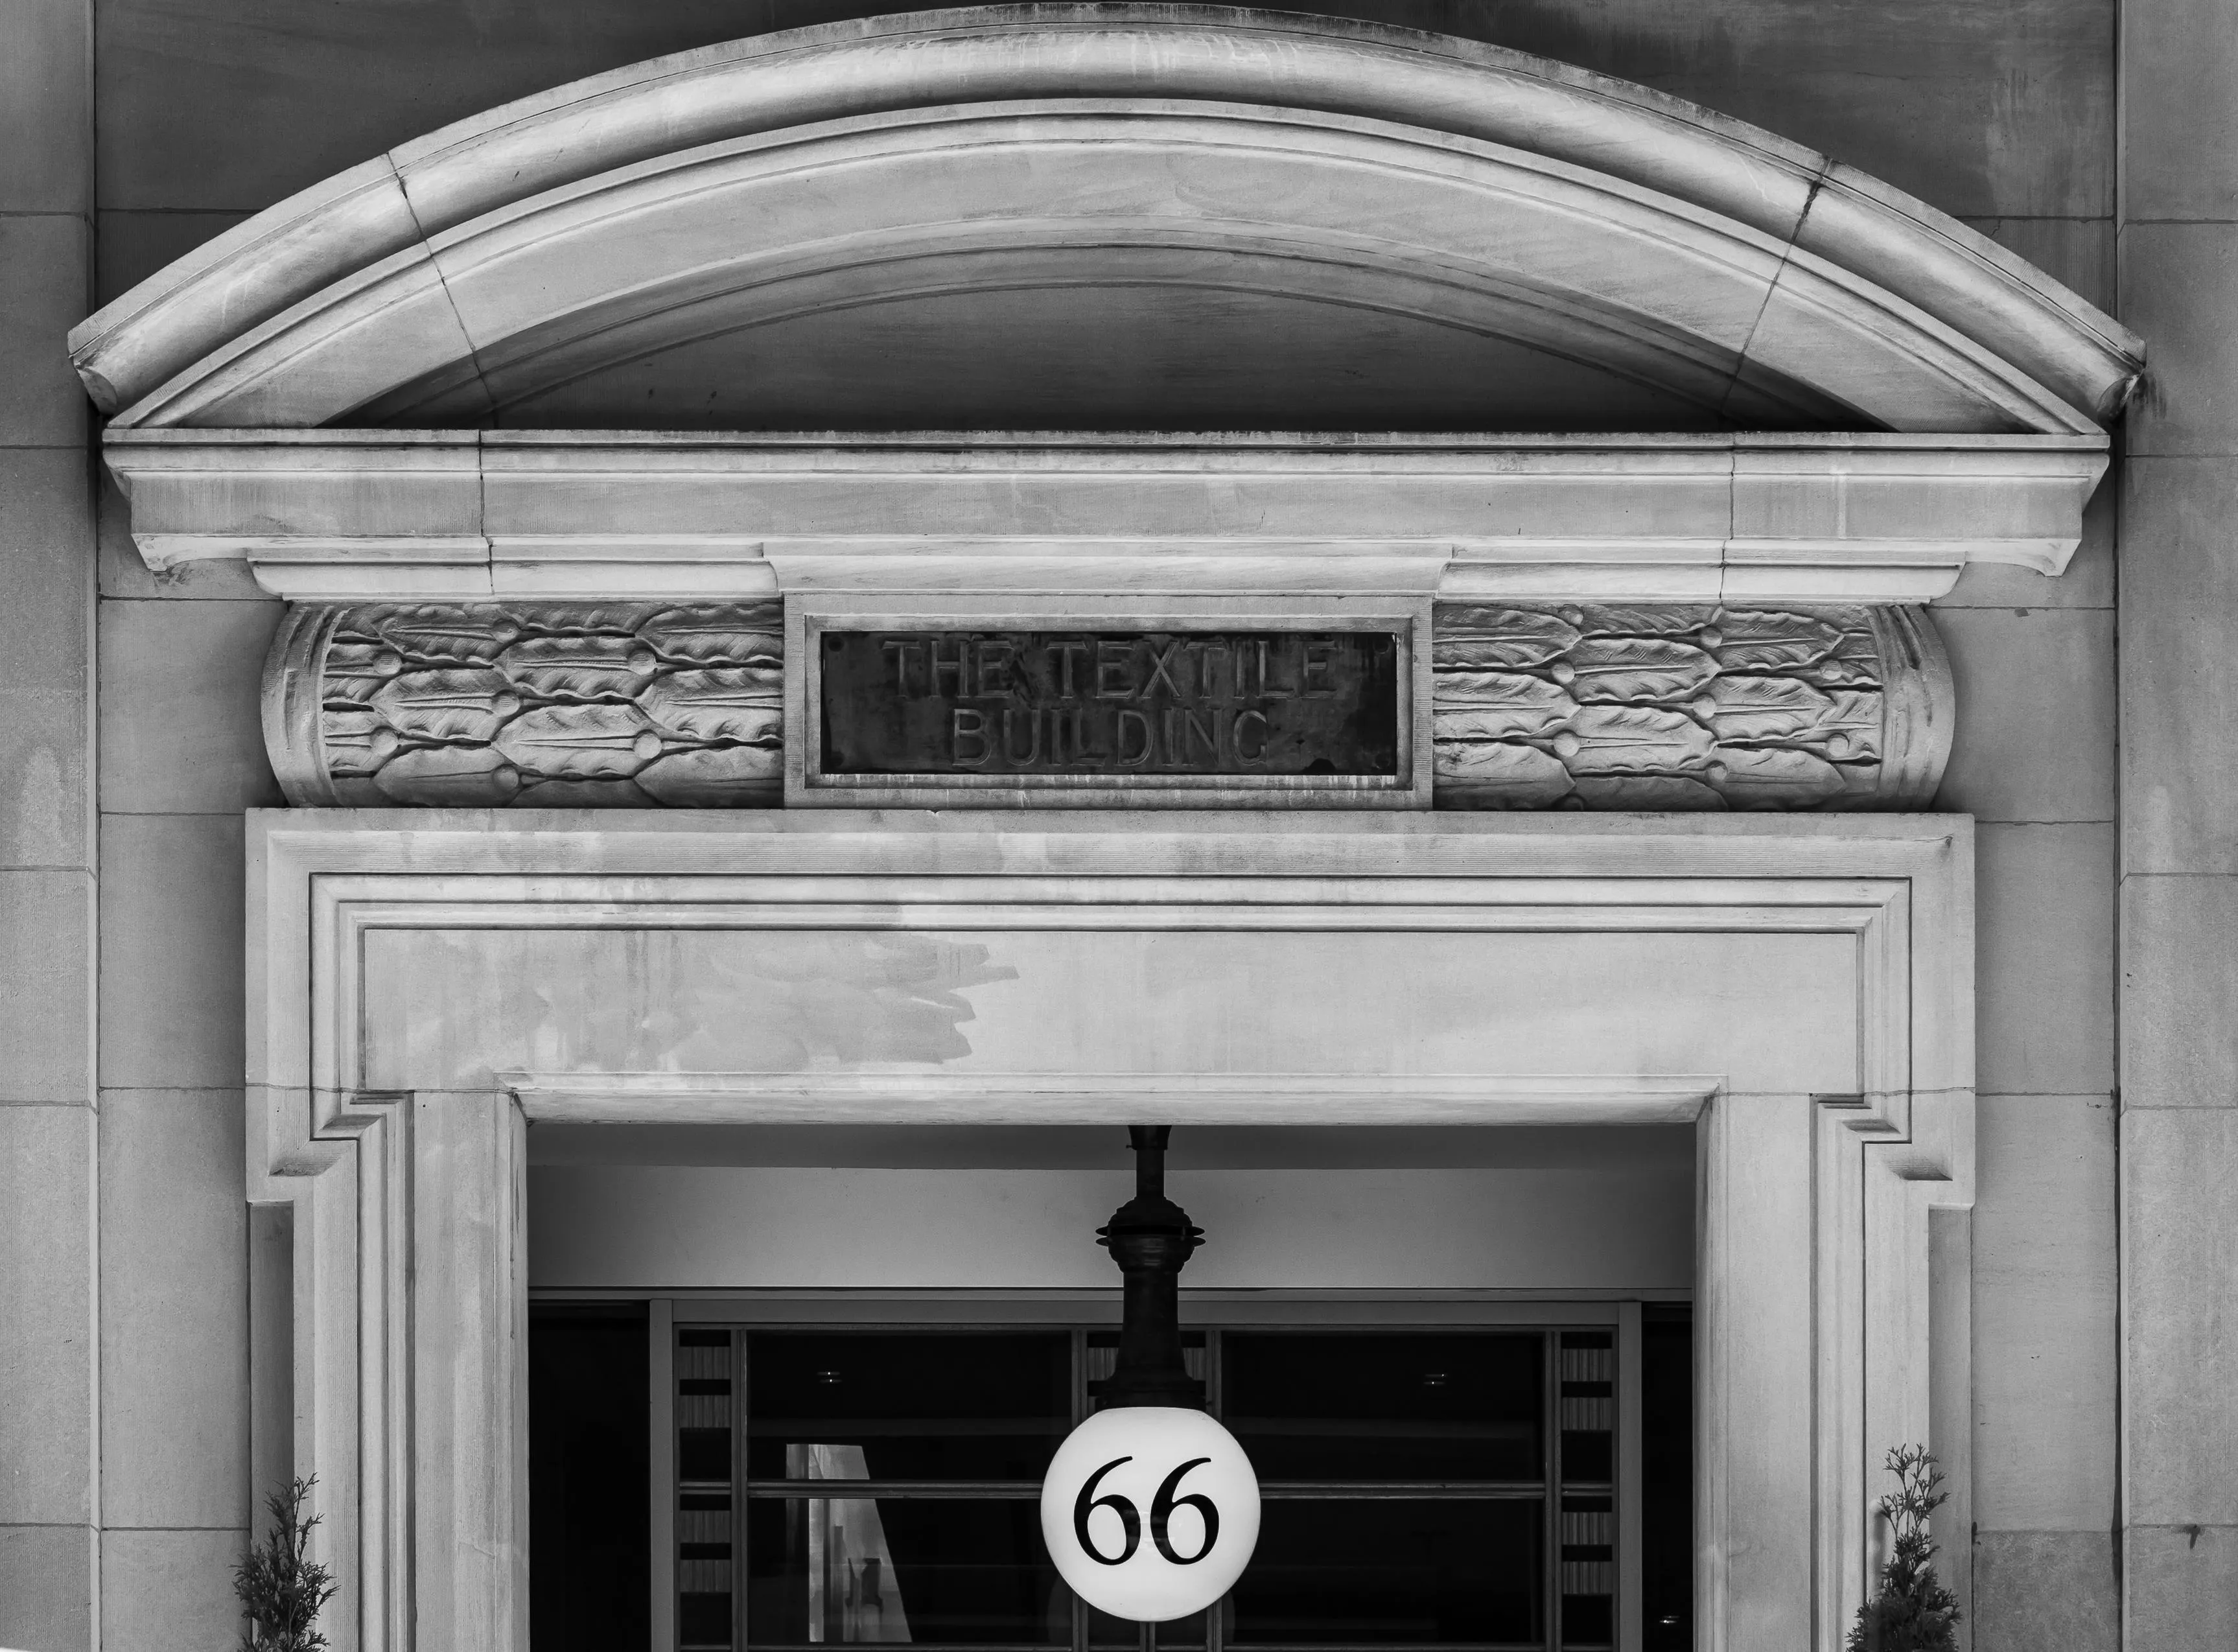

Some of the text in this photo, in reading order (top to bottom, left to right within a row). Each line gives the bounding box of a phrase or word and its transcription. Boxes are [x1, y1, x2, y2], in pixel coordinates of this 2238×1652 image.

[881, 639, 1338, 700] THE TEXTILE
[951, 708, 1269, 767] BUILDING
[1073, 1456, 1220, 1566] 66
